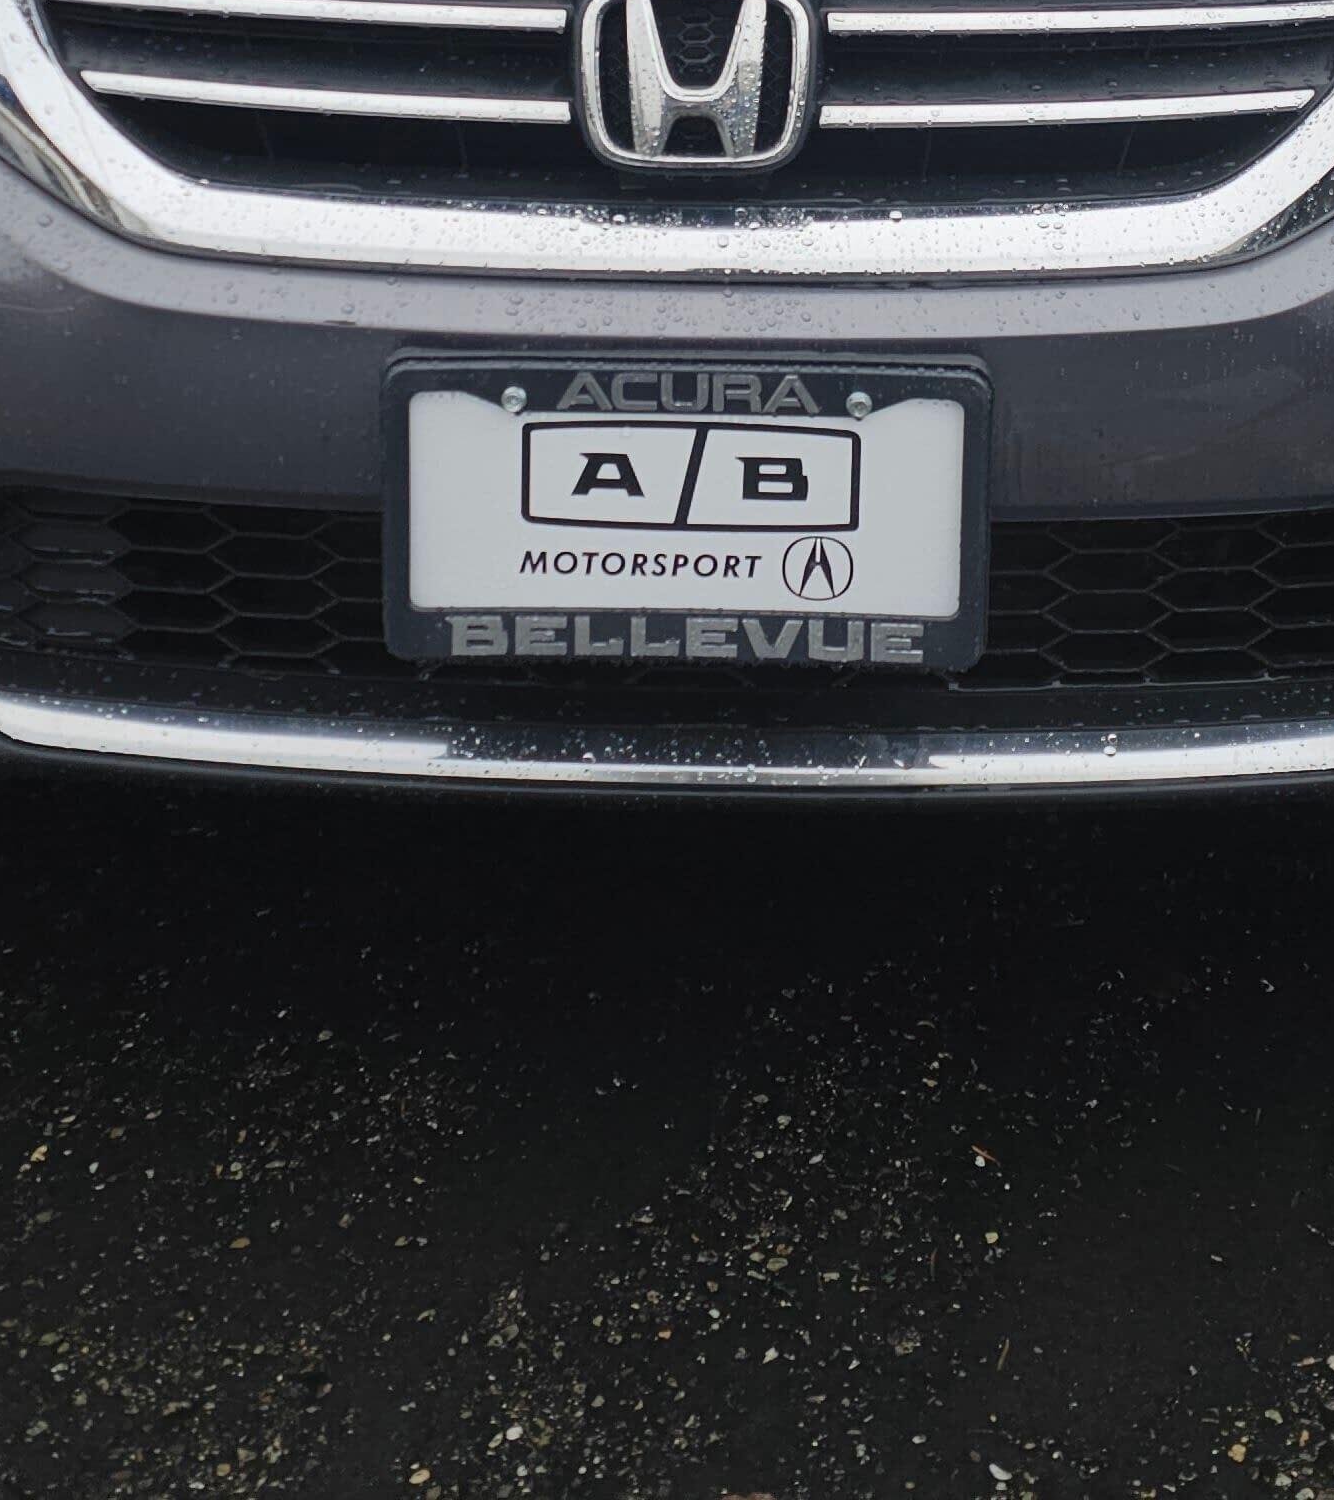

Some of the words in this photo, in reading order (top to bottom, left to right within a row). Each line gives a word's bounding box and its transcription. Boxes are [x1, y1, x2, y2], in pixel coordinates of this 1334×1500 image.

[555, 371, 821, 414] ACURA
[571, 452, 646, 498] A
[735, 456, 809, 501] B
[519, 550, 762, 579] MOTORSPORT
[444, 614, 925, 663] BELLEVUE
